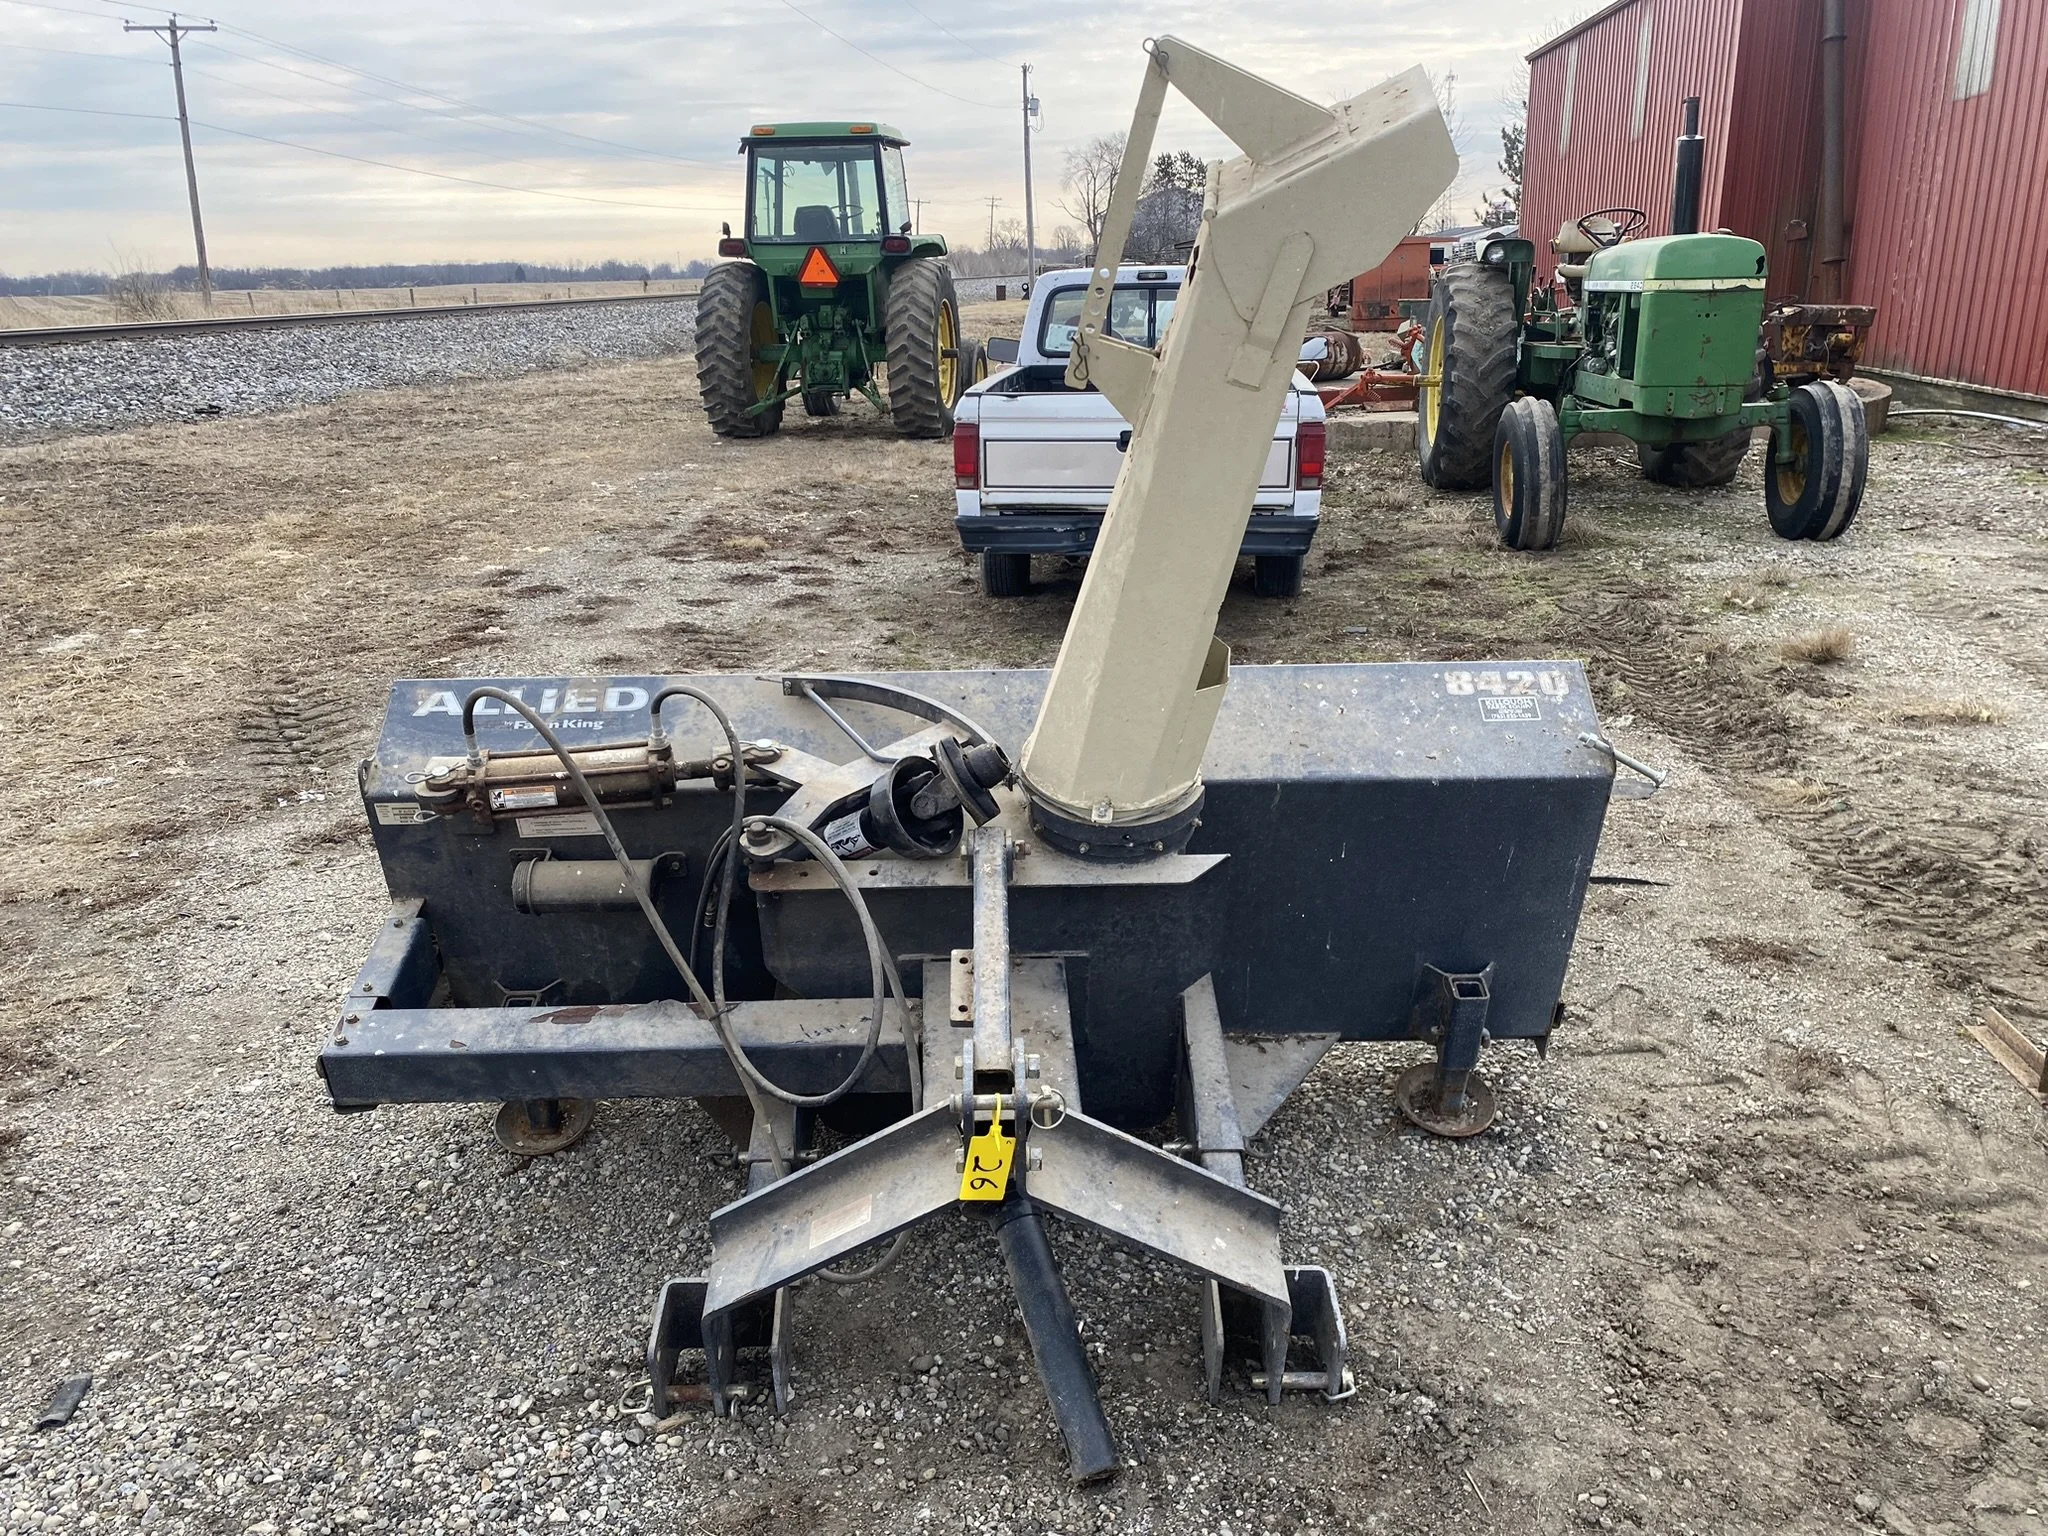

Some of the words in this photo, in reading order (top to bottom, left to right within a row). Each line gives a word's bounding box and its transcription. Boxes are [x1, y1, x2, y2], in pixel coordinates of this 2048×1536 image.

[1443, 670, 1570, 696] 8420
[412, 686, 650, 717] ALLIED
[562, 719, 605, 731] King
[970, 1155, 1003, 1190] 26
